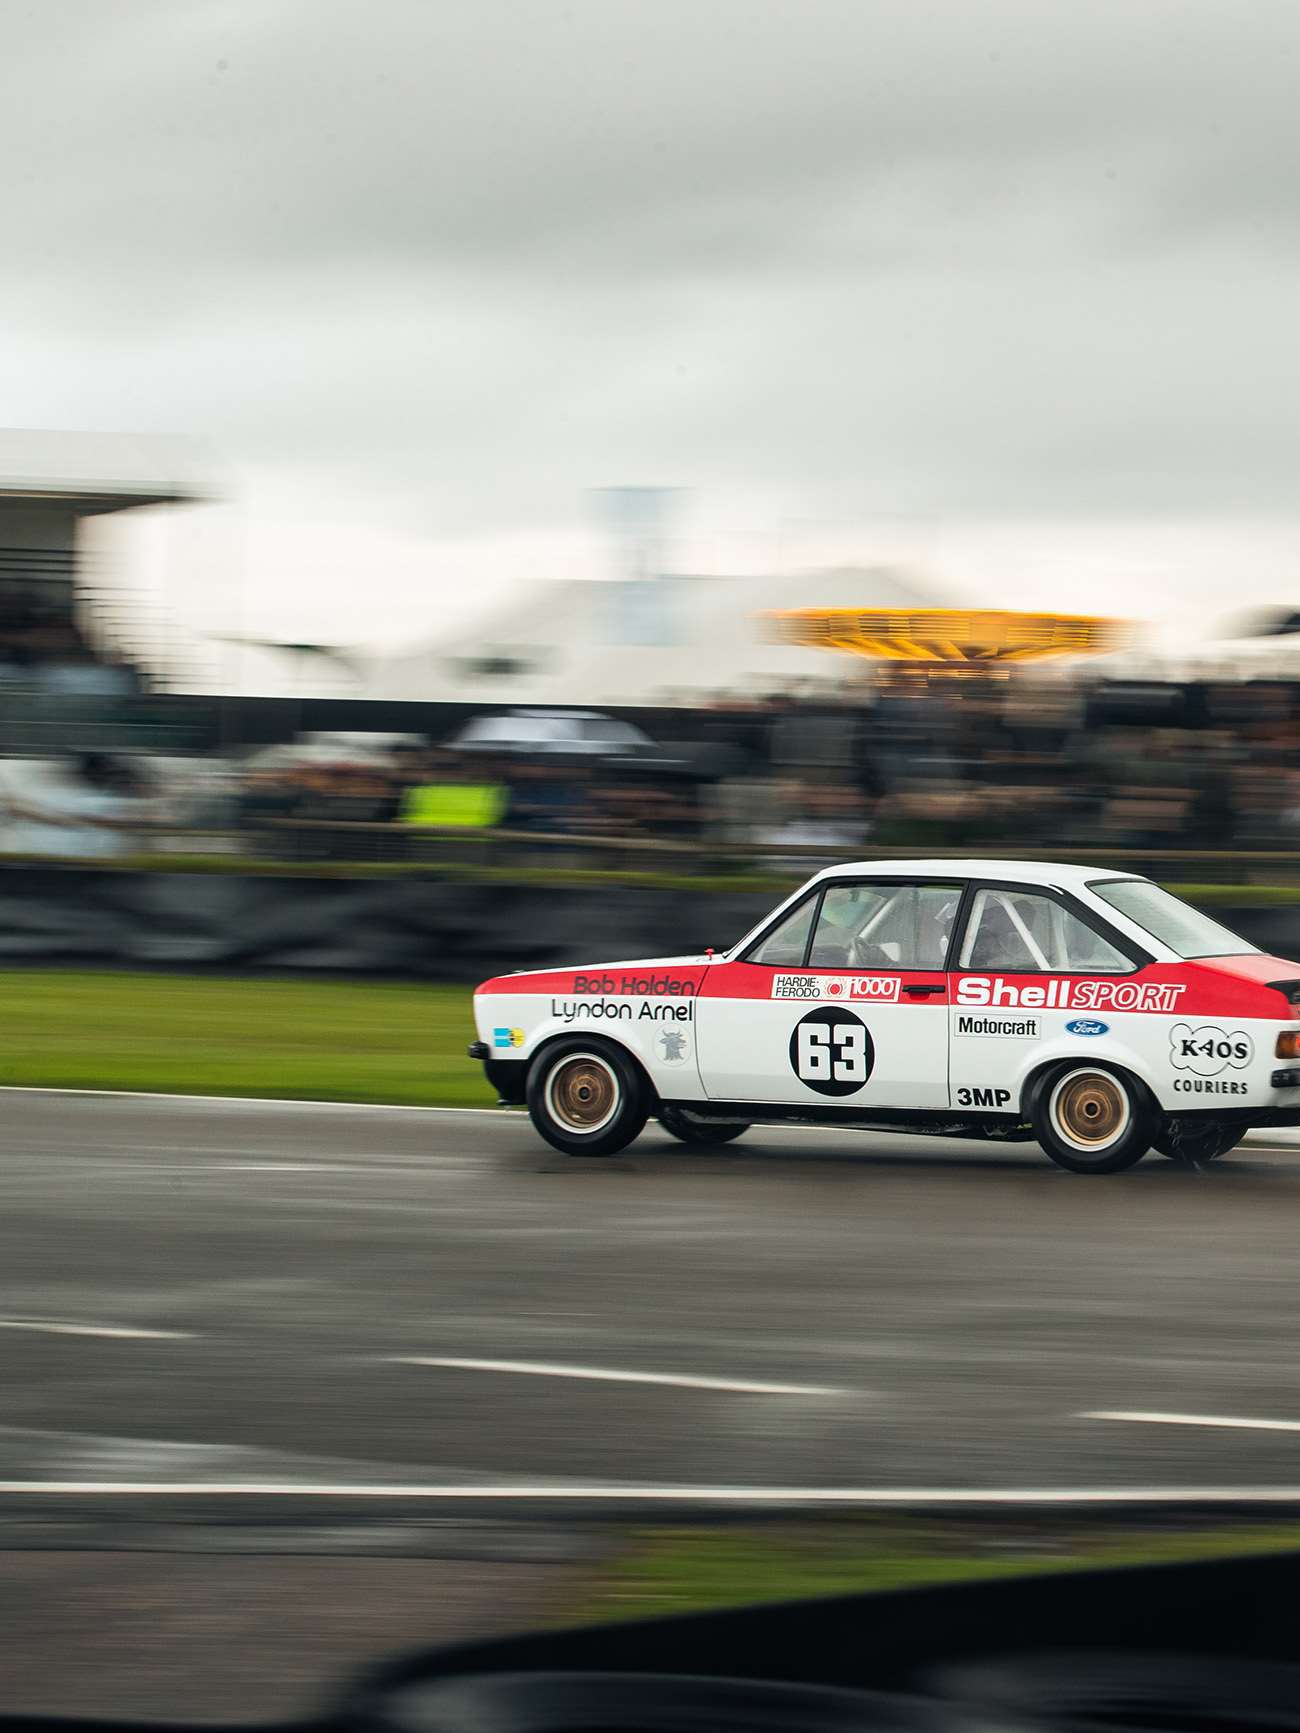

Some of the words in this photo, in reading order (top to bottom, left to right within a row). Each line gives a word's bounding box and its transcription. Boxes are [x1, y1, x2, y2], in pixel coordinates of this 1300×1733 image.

[574, 975, 616, 995] Bob
[621, 976, 695, 996] Holden
[775, 987, 820, 998] FERODO
[850, 978, 896, 996] 1000
[552, 998, 632, 1023] Lyndon
[638, 1000, 692, 1021] Arnel
[958, 1016, 1036, 1036] Motorcraft
[1073, 1022, 1101, 1034] Ford
[798, 1023, 866, 1082] 63
[1181, 1039, 1248, 1059] KAOS
[1173, 1079, 1248, 1095] COURIERS
[957, 1088, 1011, 1107] 3MP
